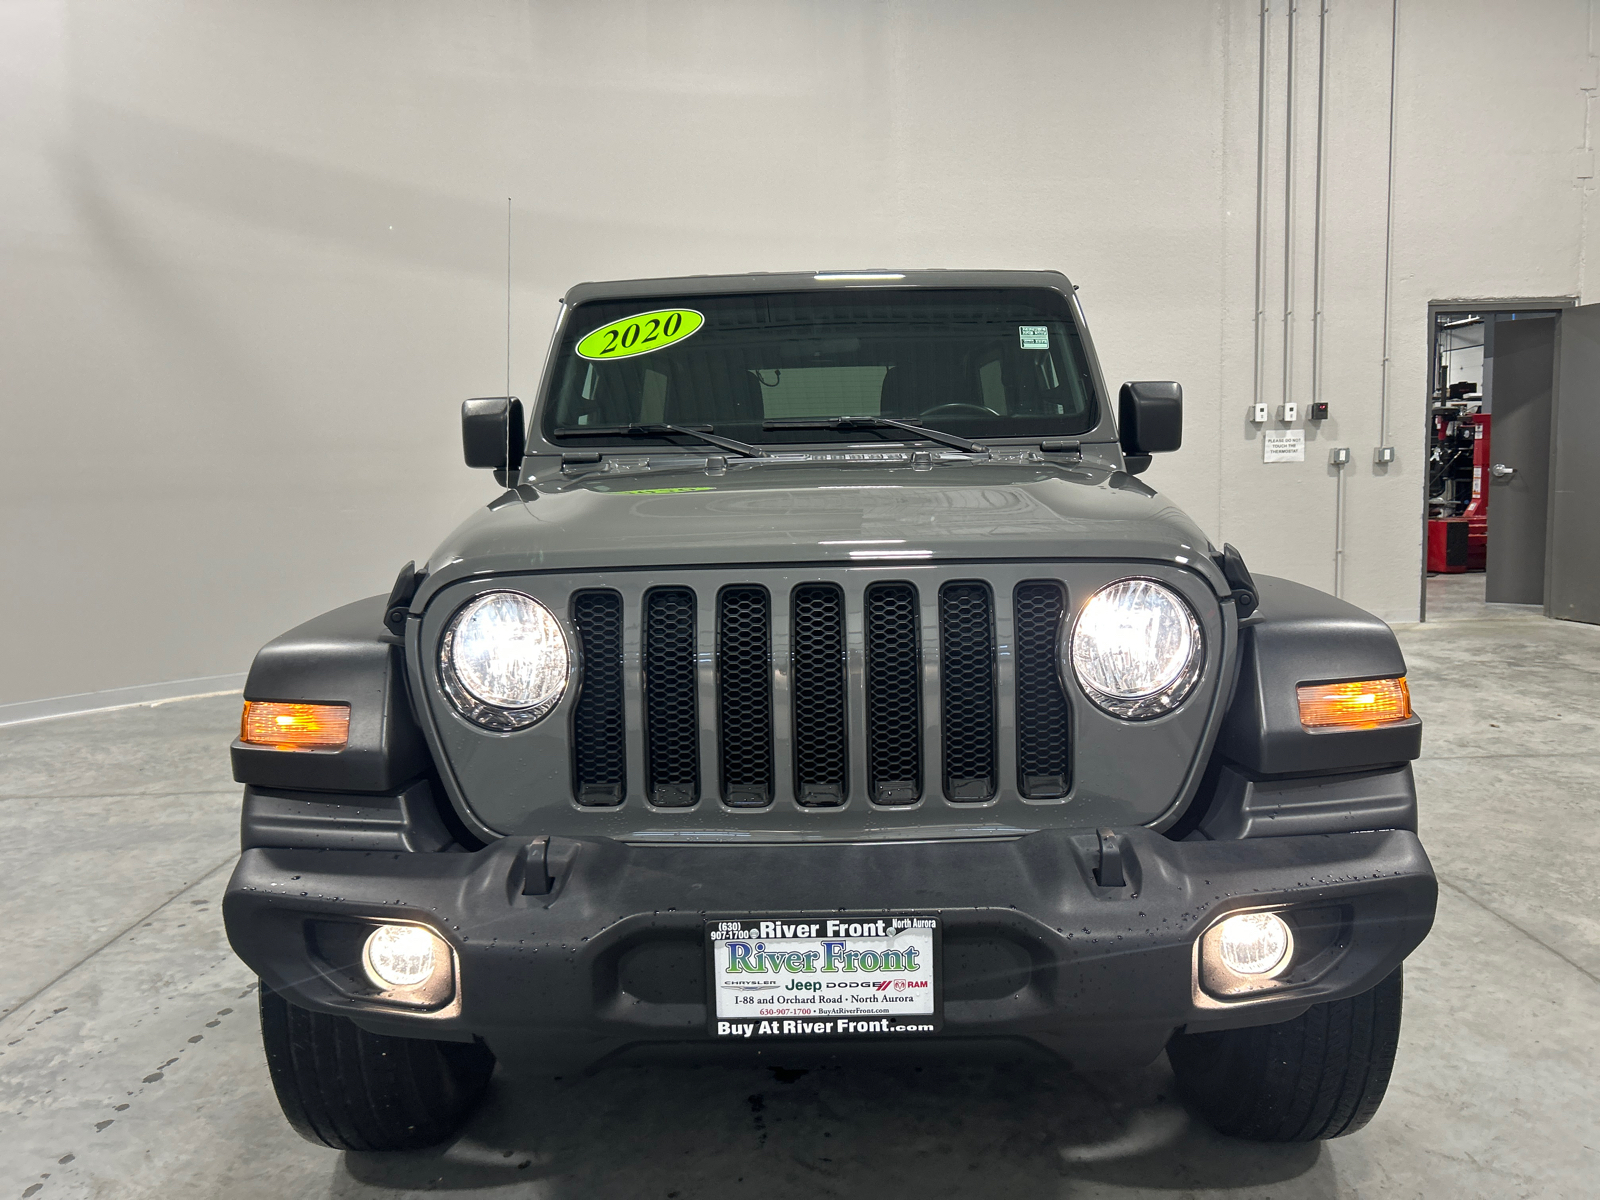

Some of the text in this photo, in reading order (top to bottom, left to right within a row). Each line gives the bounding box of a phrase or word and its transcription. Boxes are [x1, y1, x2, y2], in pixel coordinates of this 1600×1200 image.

[599, 312, 683, 356] 2020
[718, 922, 741, 931] (630)
[892, 918, 937, 928] North Aurora
[760, 920, 886, 938] River Front
[710, 930, 750, 940] 907-1700
[785, 978, 823, 992] Jeep
[826, 981, 883, 989] DODGE
[907, 980, 928, 988] RAM
[734, 993, 914, 1005] I-88 and Orchard Road North Aurora
[759, 1007, 890, 1016] 630-907-1700 BuyAtRiverFront.com
[717, 1018, 934, 1038] Buy At River Front.com
